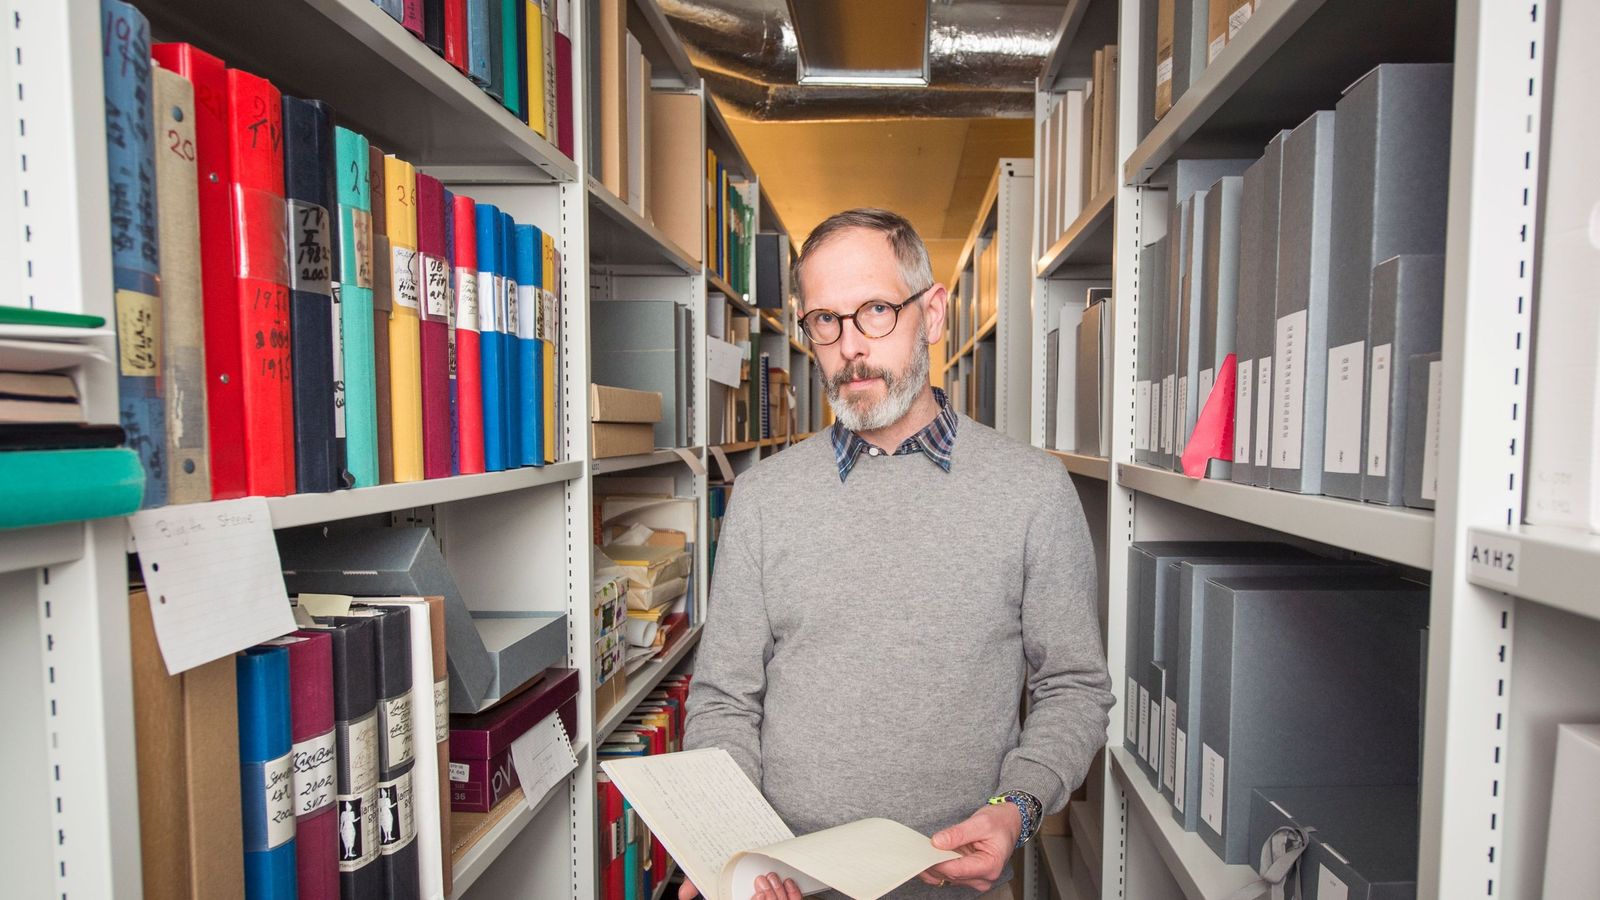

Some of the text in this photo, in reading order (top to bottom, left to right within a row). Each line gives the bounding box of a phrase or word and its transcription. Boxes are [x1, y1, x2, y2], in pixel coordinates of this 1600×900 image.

[168, 130, 195, 162] 20
[248, 118, 283, 153] TV
[397, 185, 416, 207] 26
